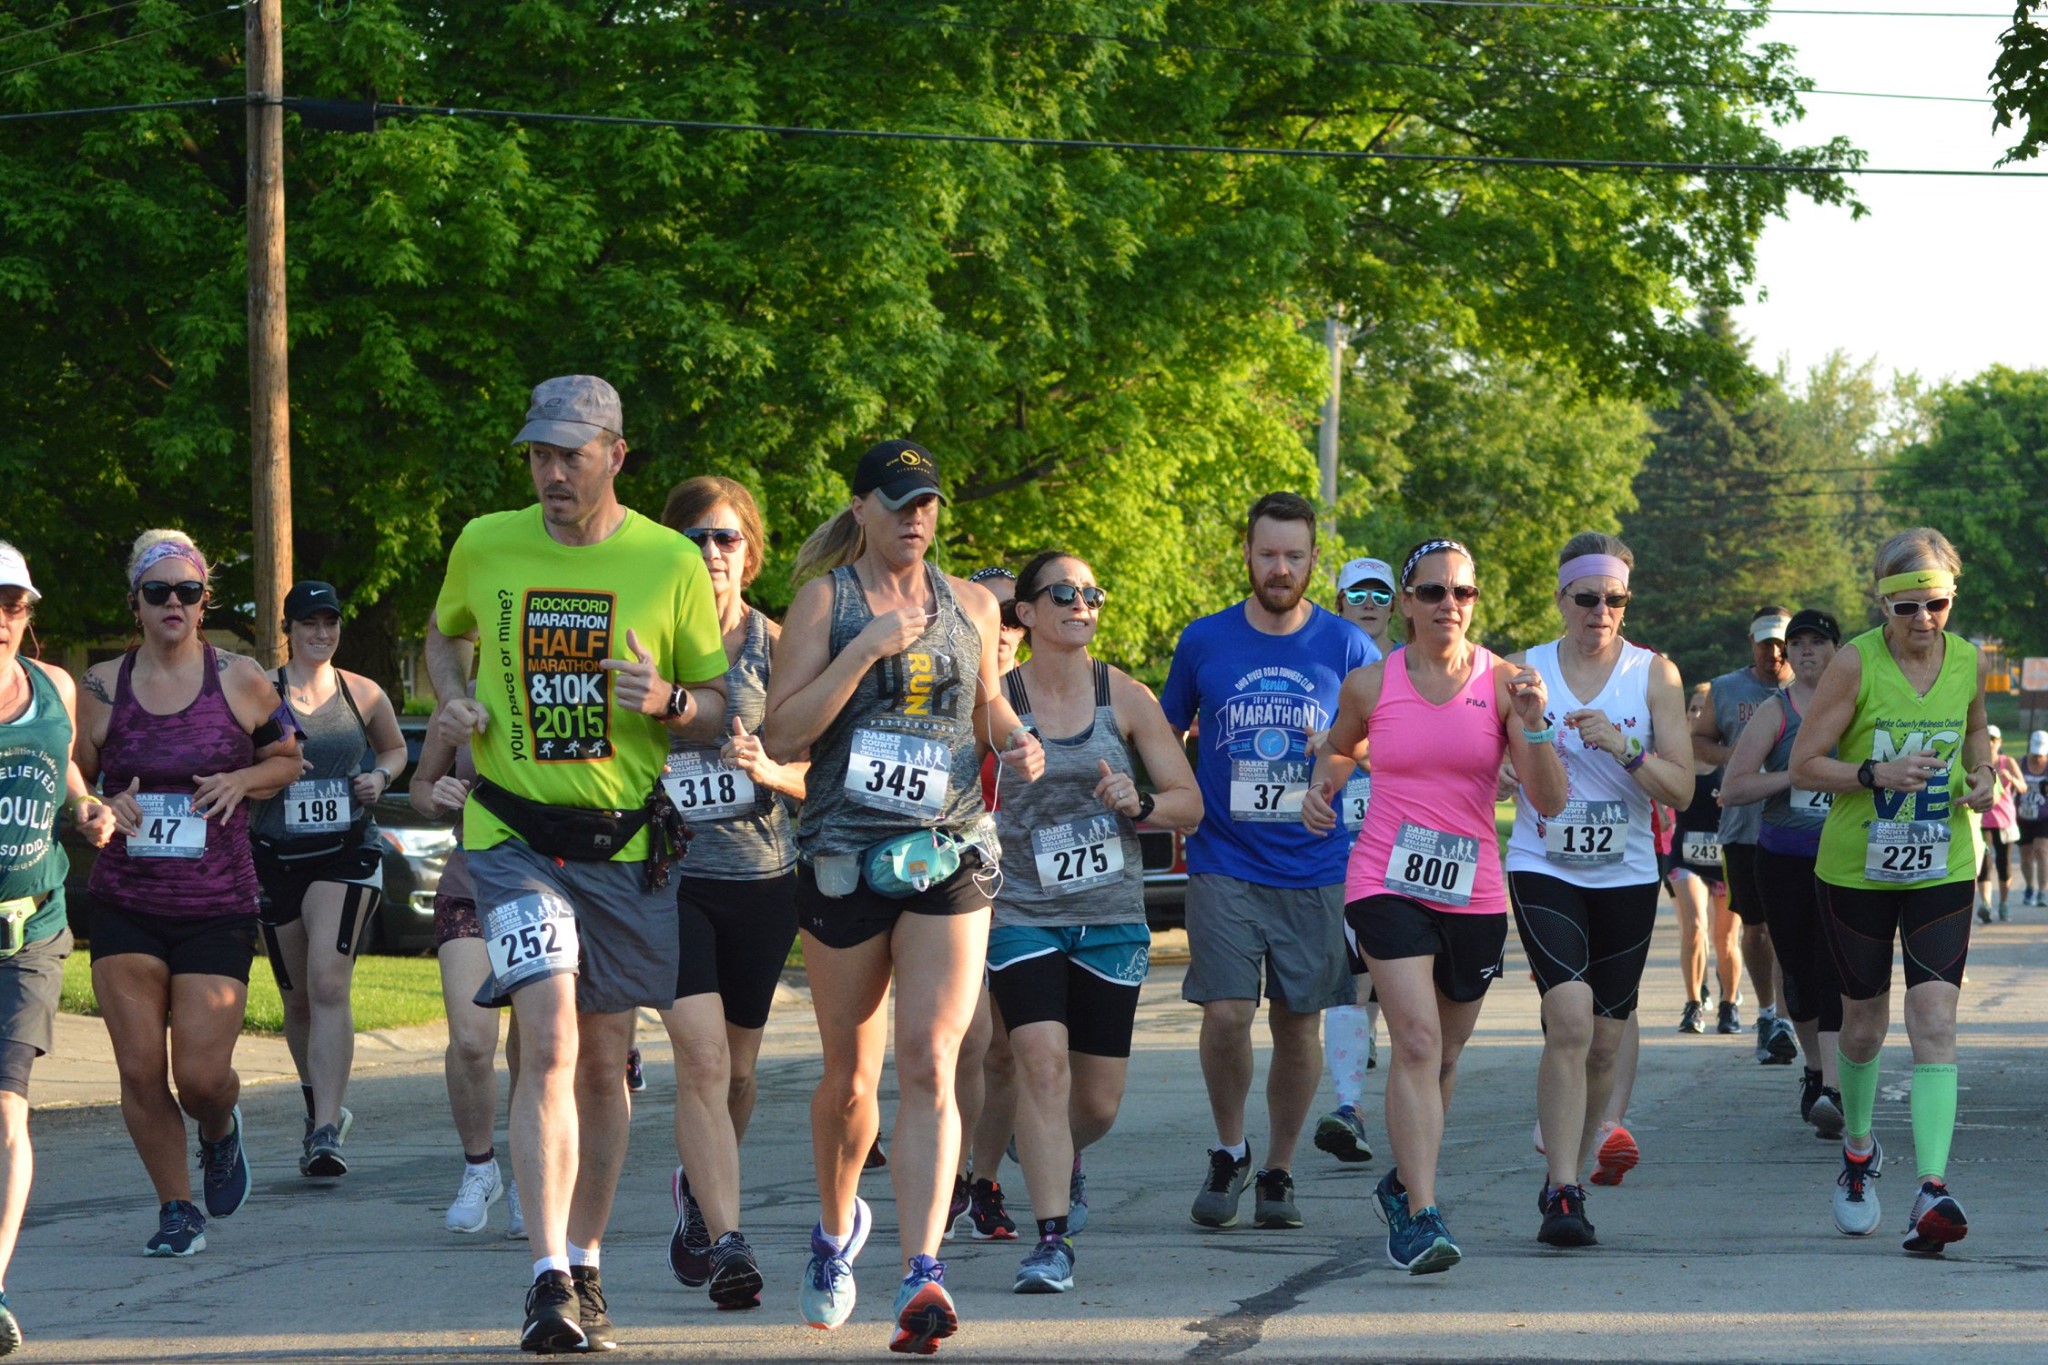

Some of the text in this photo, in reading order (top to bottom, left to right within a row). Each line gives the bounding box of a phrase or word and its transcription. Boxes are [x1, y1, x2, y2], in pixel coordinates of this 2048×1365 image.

[530, 597, 610, 614] ROCKFORD
[528, 612, 608, 630] MARATHON
[529, 627, 607, 658] HALF
[528, 658, 604, 673] MARATHON
[498, 589, 527, 762] your pace or mine?
[904, 653, 934, 715] RUN
[1246, 668, 1263, 683] RIVER
[1263, 666, 1278, 677] ROAD
[1300, 677, 1315, 693] CLUB
[530, 673, 604, 704] &10K
[1465, 697, 1487, 708] FILA
[535, 705, 604, 739] 2015
[1230, 701, 1315, 730] MARATHON
[1896, 718, 1918, 729] County
[870, 719, 955, 733] PITTSBURGH
[861, 739, 900, 750] COUNTY
[862, 731, 901, 744] DARKE
[667, 751, 701, 762] DARKE
[860, 750, 898, 760] CHALLENGE
[861, 745, 899, 755] WELLNESS
[667, 759, 701, 767] COUNTY
[0, 765, 55, 794] ELIEVED
[865, 760, 929, 801] 345
[679, 773, 736, 808] 318
[1254, 784, 1285, 810] 37
[0, 795, 51, 830] OULD
[298, 800, 337, 823] 198
[1353, 798, 1370, 820] 3
[149, 818, 181, 844] 47
[1038, 823, 1073, 837] DARKE
[1040, 831, 1073, 843] COUNTY
[1405, 832, 1437, 845] COUNTY
[1406, 824, 1440, 839] DARKE
[1041, 837, 1075, 848] WELLNESS
[1042, 842, 1075, 853] CHALLENGE
[1403, 838, 1436, 849] WELLNESS
[1563, 826, 1613, 853] 132
[0, 844, 18, 856] SO
[1402, 843, 1435, 854] CHALLENGE
[1691, 844, 1718, 860] 243
[1053, 843, 1108, 882] 275
[1882, 845, 1933, 871] 225
[1404, 853, 1460, 890] 800
[501, 922, 562, 968] 252
